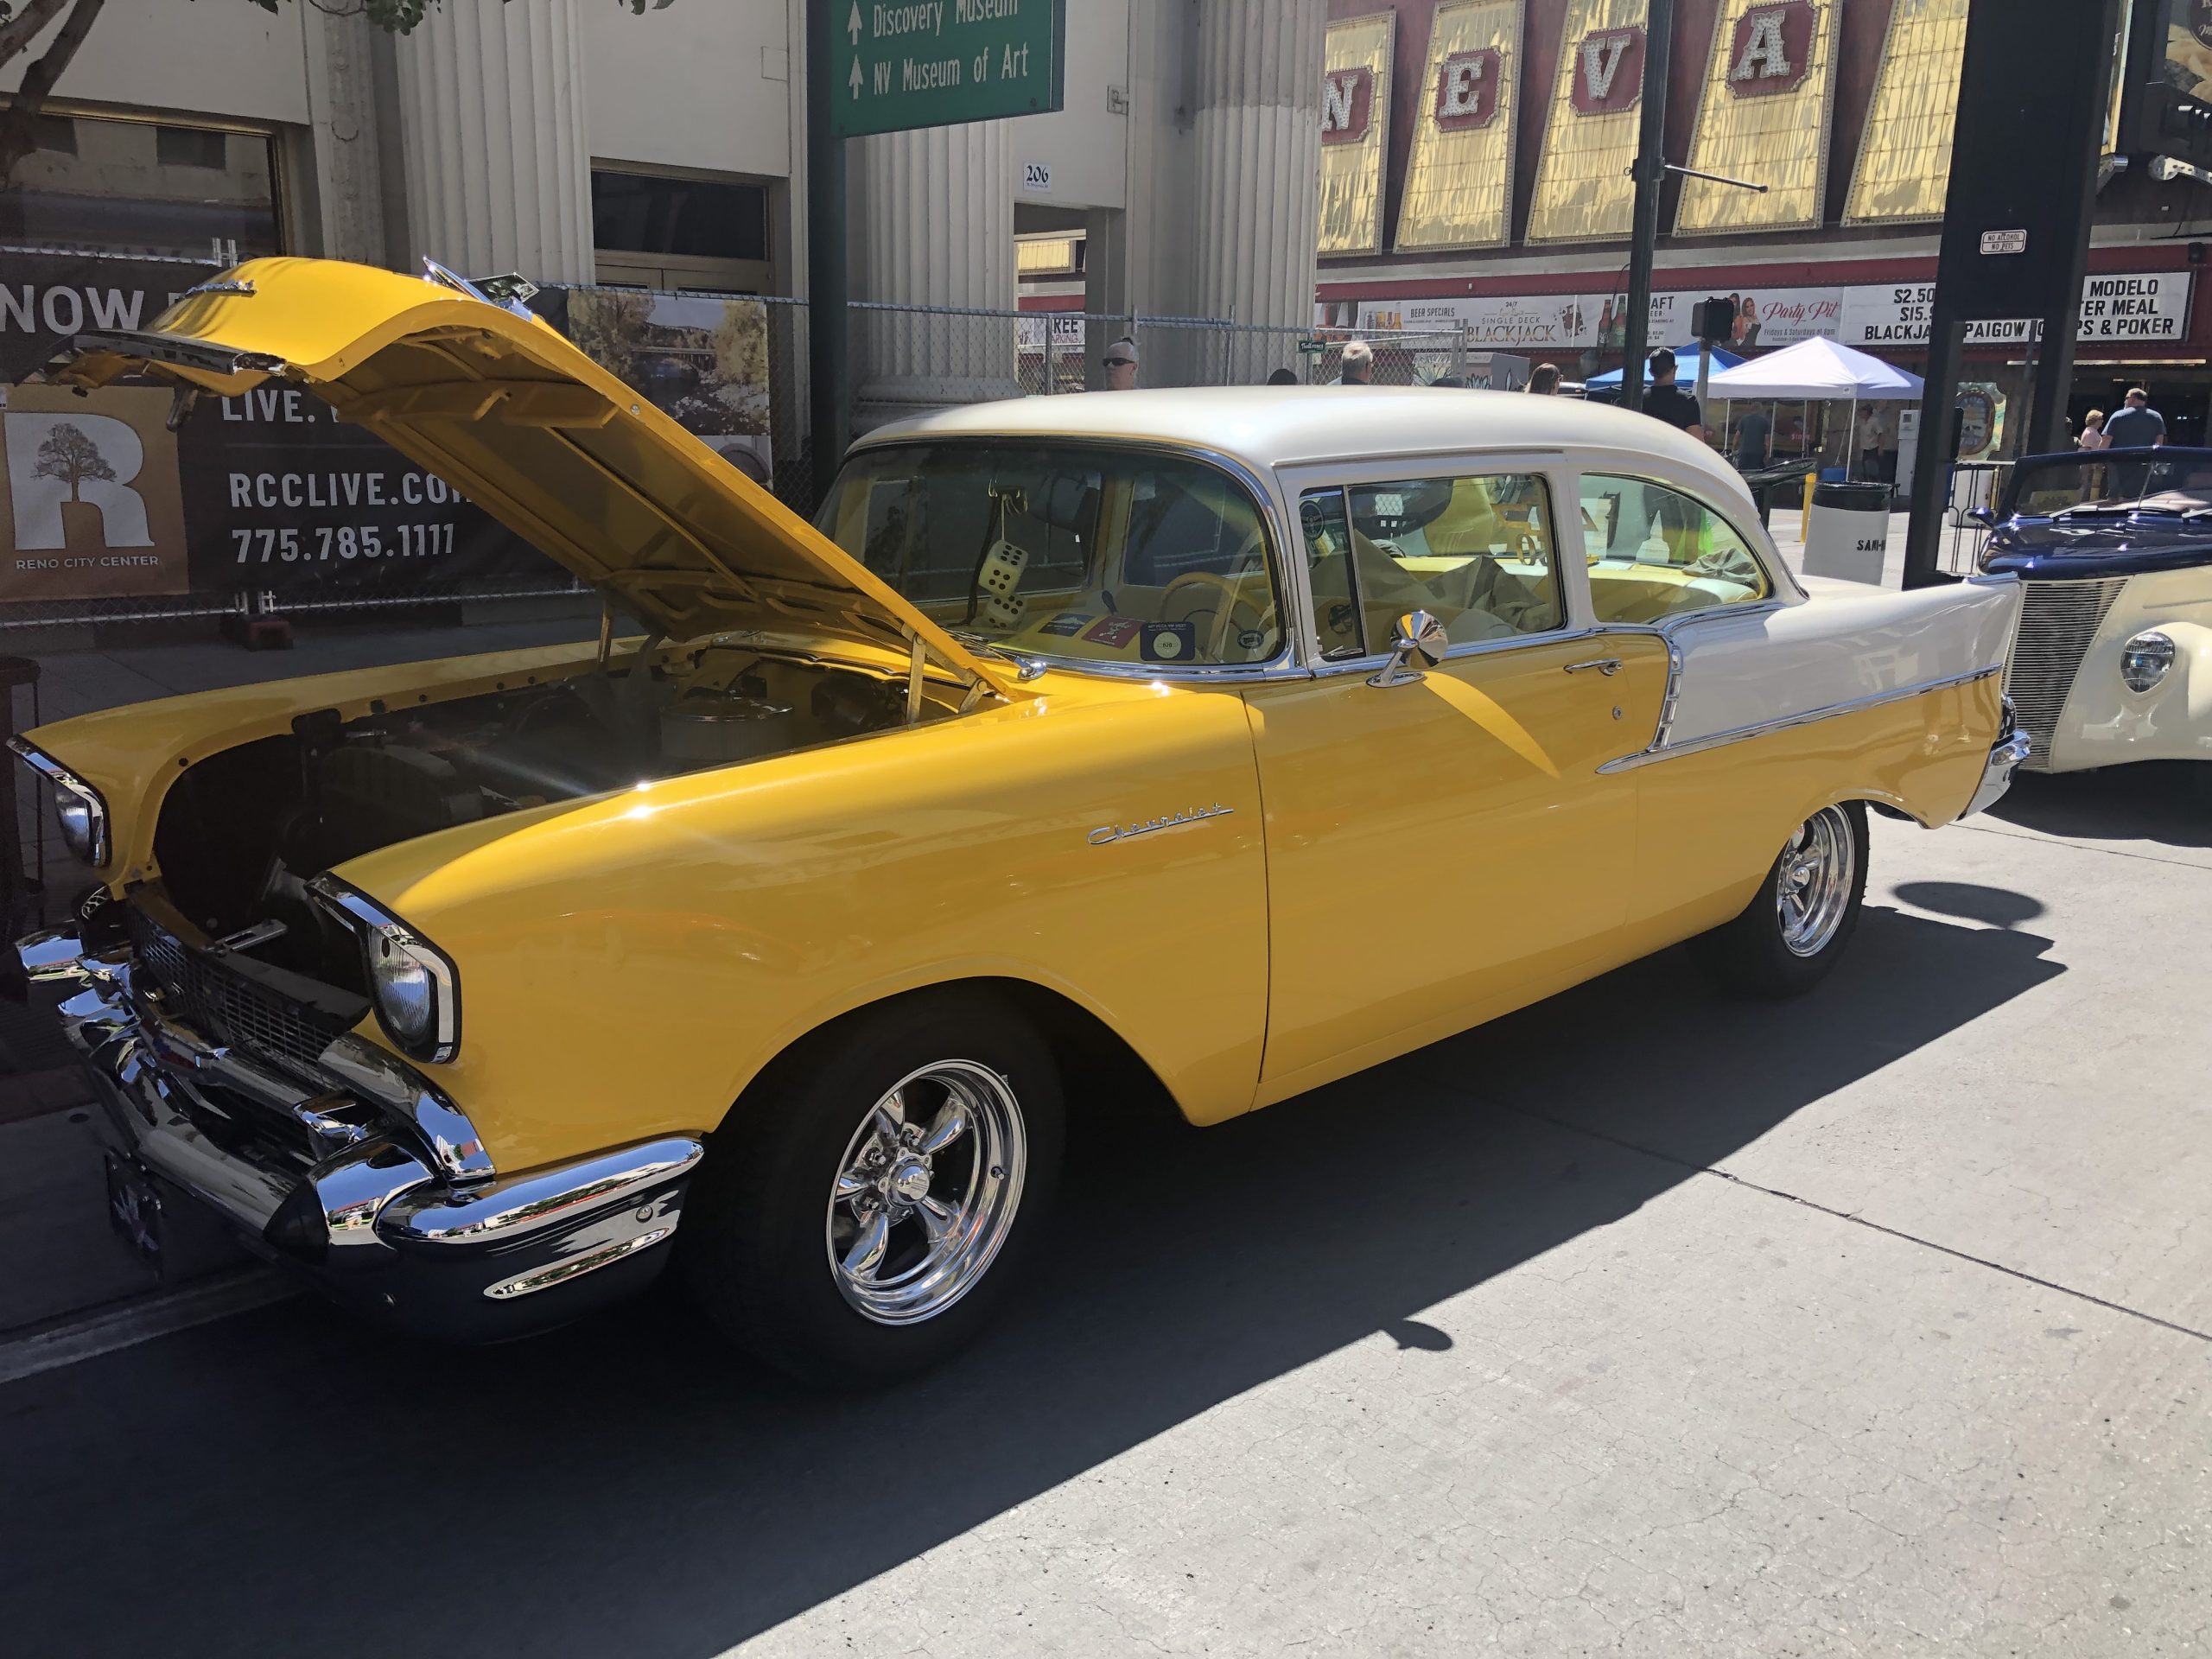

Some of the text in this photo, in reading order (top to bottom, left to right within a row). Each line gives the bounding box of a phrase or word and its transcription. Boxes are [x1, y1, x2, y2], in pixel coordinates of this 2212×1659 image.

[874, 0, 1018, 37] Discovery Museum
[874, 41, 1029, 95] NV Museum of Art
[1027, 165, 1049, 183] 206
[2089, 278, 2159, 297] MODELO
[0, 283, 145, 335] NOW
[1410, 307, 1455, 318] BEER SPECIALS
[1650, 296, 1675, 309] AFT
[1763, 300, 1840, 327] Party Pit
[2112, 298, 2158, 315] MEAL
[1053, 318, 1078, 334] REE
[1466, 324, 1557, 346] BLACKJACK
[1865, 324, 1931, 340] BLACKJA
[1964, 321, 2026, 338] PAIGOW
[2100, 319, 2113, 335] &
[2116, 317, 2174, 334] POKER
[1052, 334, 1079, 344] ARKING
[221, 389, 316, 423] LIVE.
[229, 472, 473, 508] RCCLIVE.CO
[232, 523, 454, 563] 775.785.1111
[16, 556, 159, 570] RENO CITY CENTER
